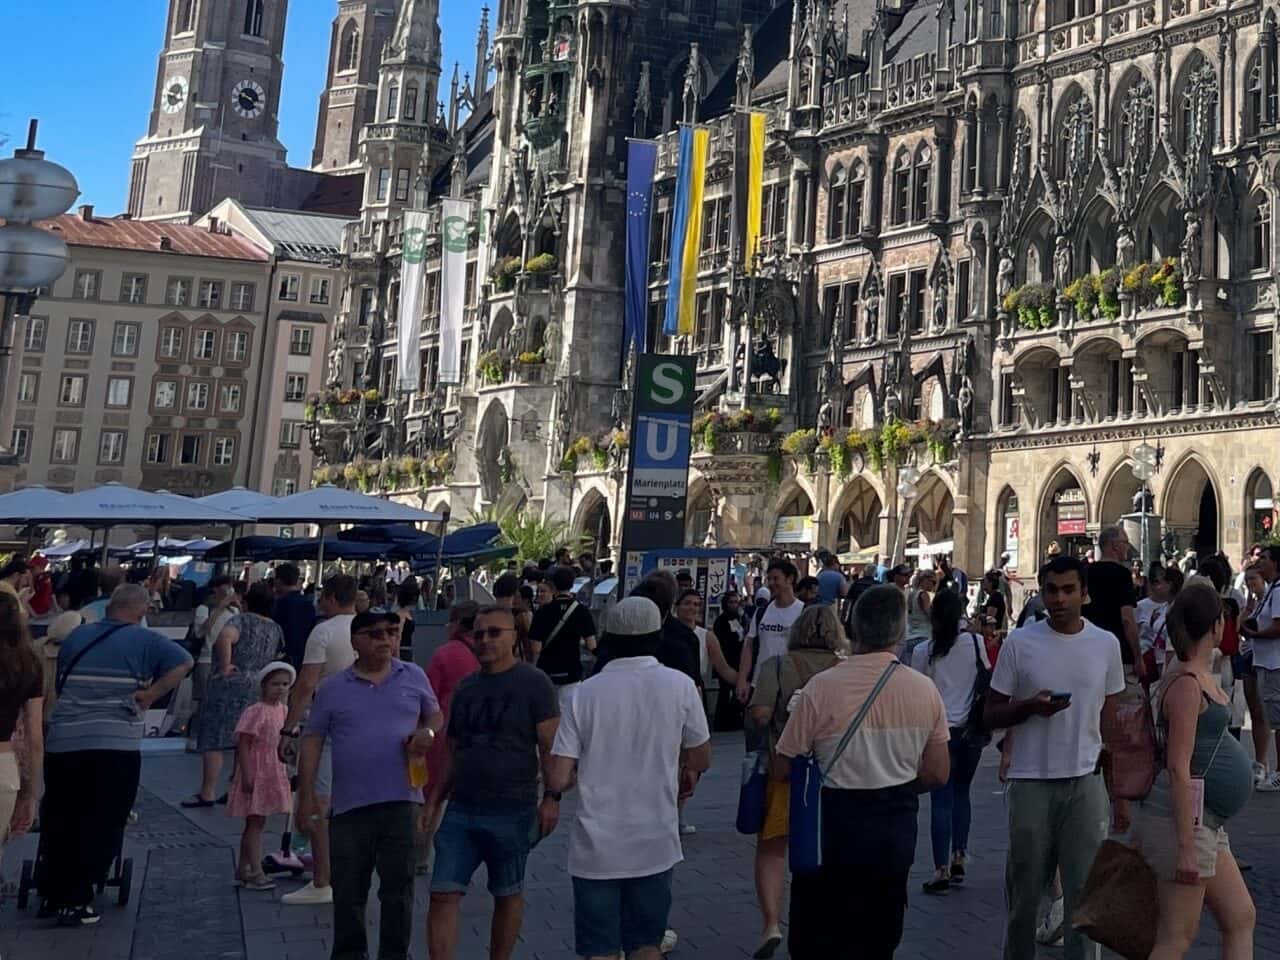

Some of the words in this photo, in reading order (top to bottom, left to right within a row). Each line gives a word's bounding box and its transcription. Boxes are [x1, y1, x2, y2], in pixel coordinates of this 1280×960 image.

[650, 362, 684, 405] S
[647, 419, 678, 461] U
[633, 479, 685, 490] Marienplatz
[664, 510, 673, 521] S
